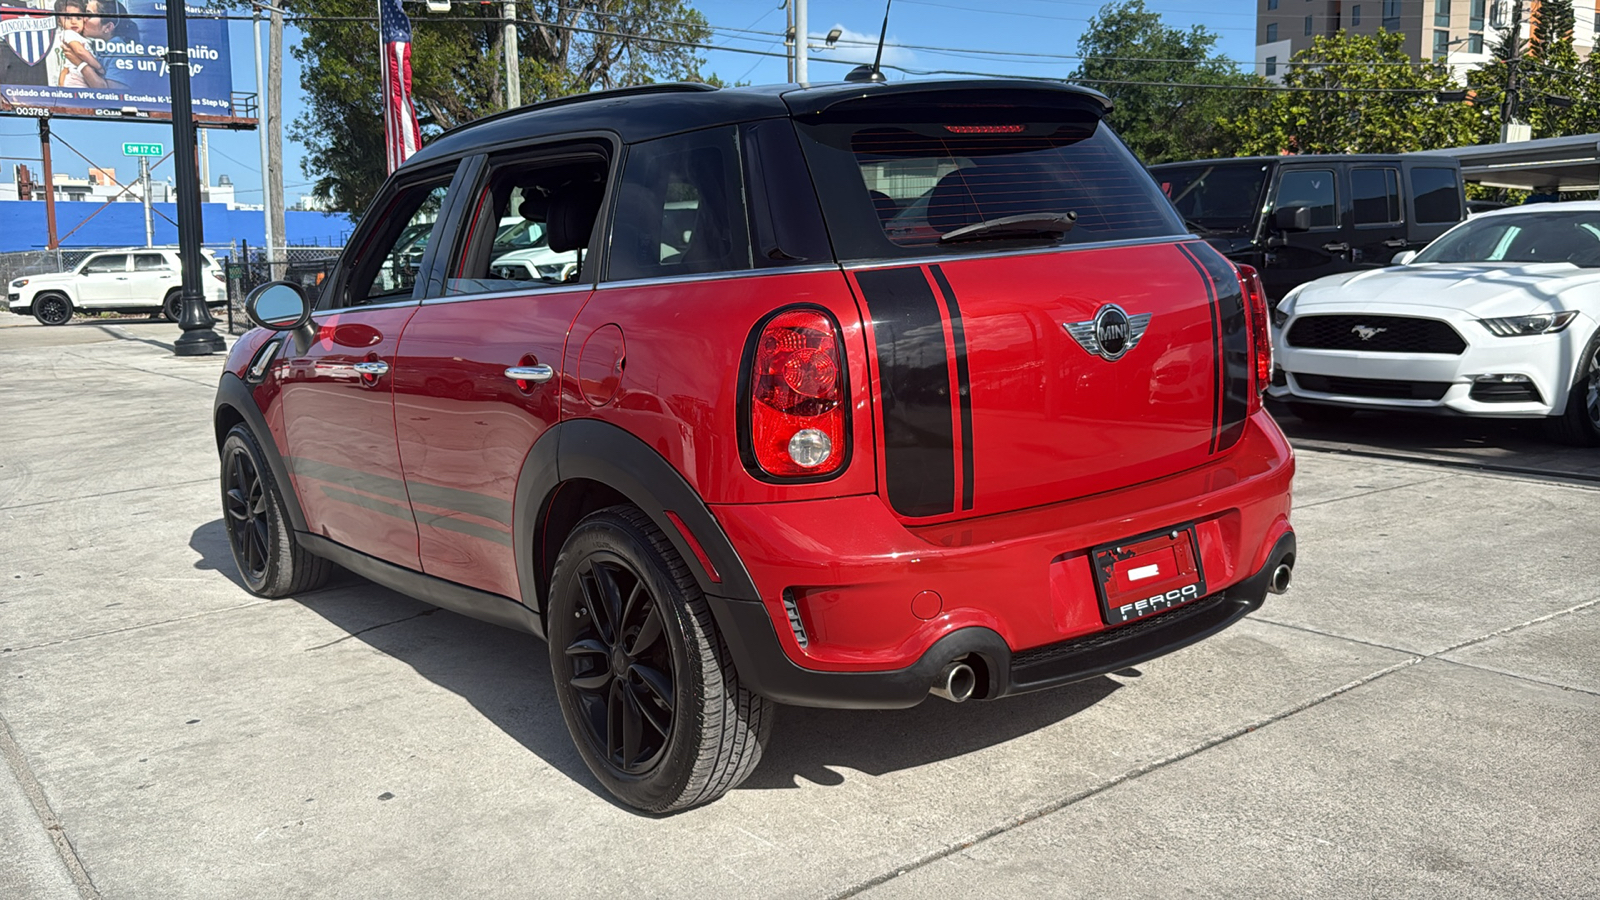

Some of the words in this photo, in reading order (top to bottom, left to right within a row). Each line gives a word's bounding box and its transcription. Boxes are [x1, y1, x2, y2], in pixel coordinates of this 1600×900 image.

[95, 39, 144, 55] Donde
[187, 45, 219, 60] niño
[116, 59, 133, 70] es
[137, 60, 157, 72] un
[6, 88, 38, 97] Cuidado
[40, 90, 50, 98] de
[52, 90, 73, 99] niños
[78, 92, 95, 100] VPK
[96, 93, 119, 101] Gratis
[124, 95, 157, 103] Escuelas
[201, 98, 218, 107] Step
[219, 99, 229, 108] Up
[16, 107, 50, 116] 003785
[140, 146, 149, 154] 17
[1100, 323, 1128, 341] MINI
[1120, 584, 1197, 614] FERCO
